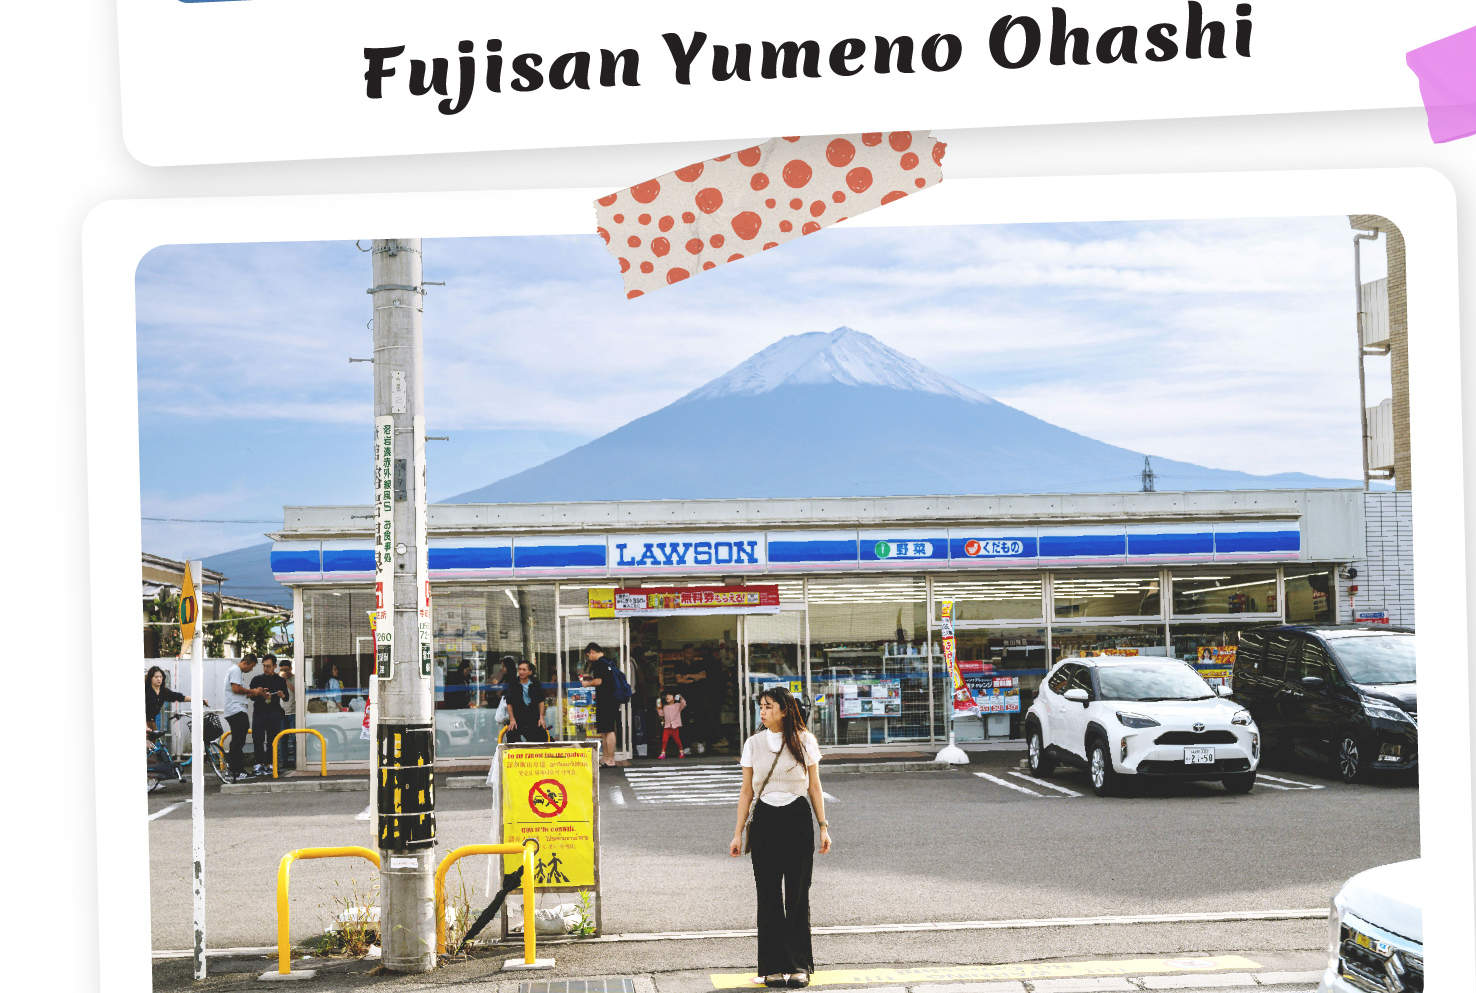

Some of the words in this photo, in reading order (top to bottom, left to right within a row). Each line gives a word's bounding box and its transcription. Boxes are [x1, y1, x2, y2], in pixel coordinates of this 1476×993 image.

[616, 541, 759, 566] LAWSON
[896, 543, 926, 555] 野菜
[983, 542, 1020, 553] くだもの
